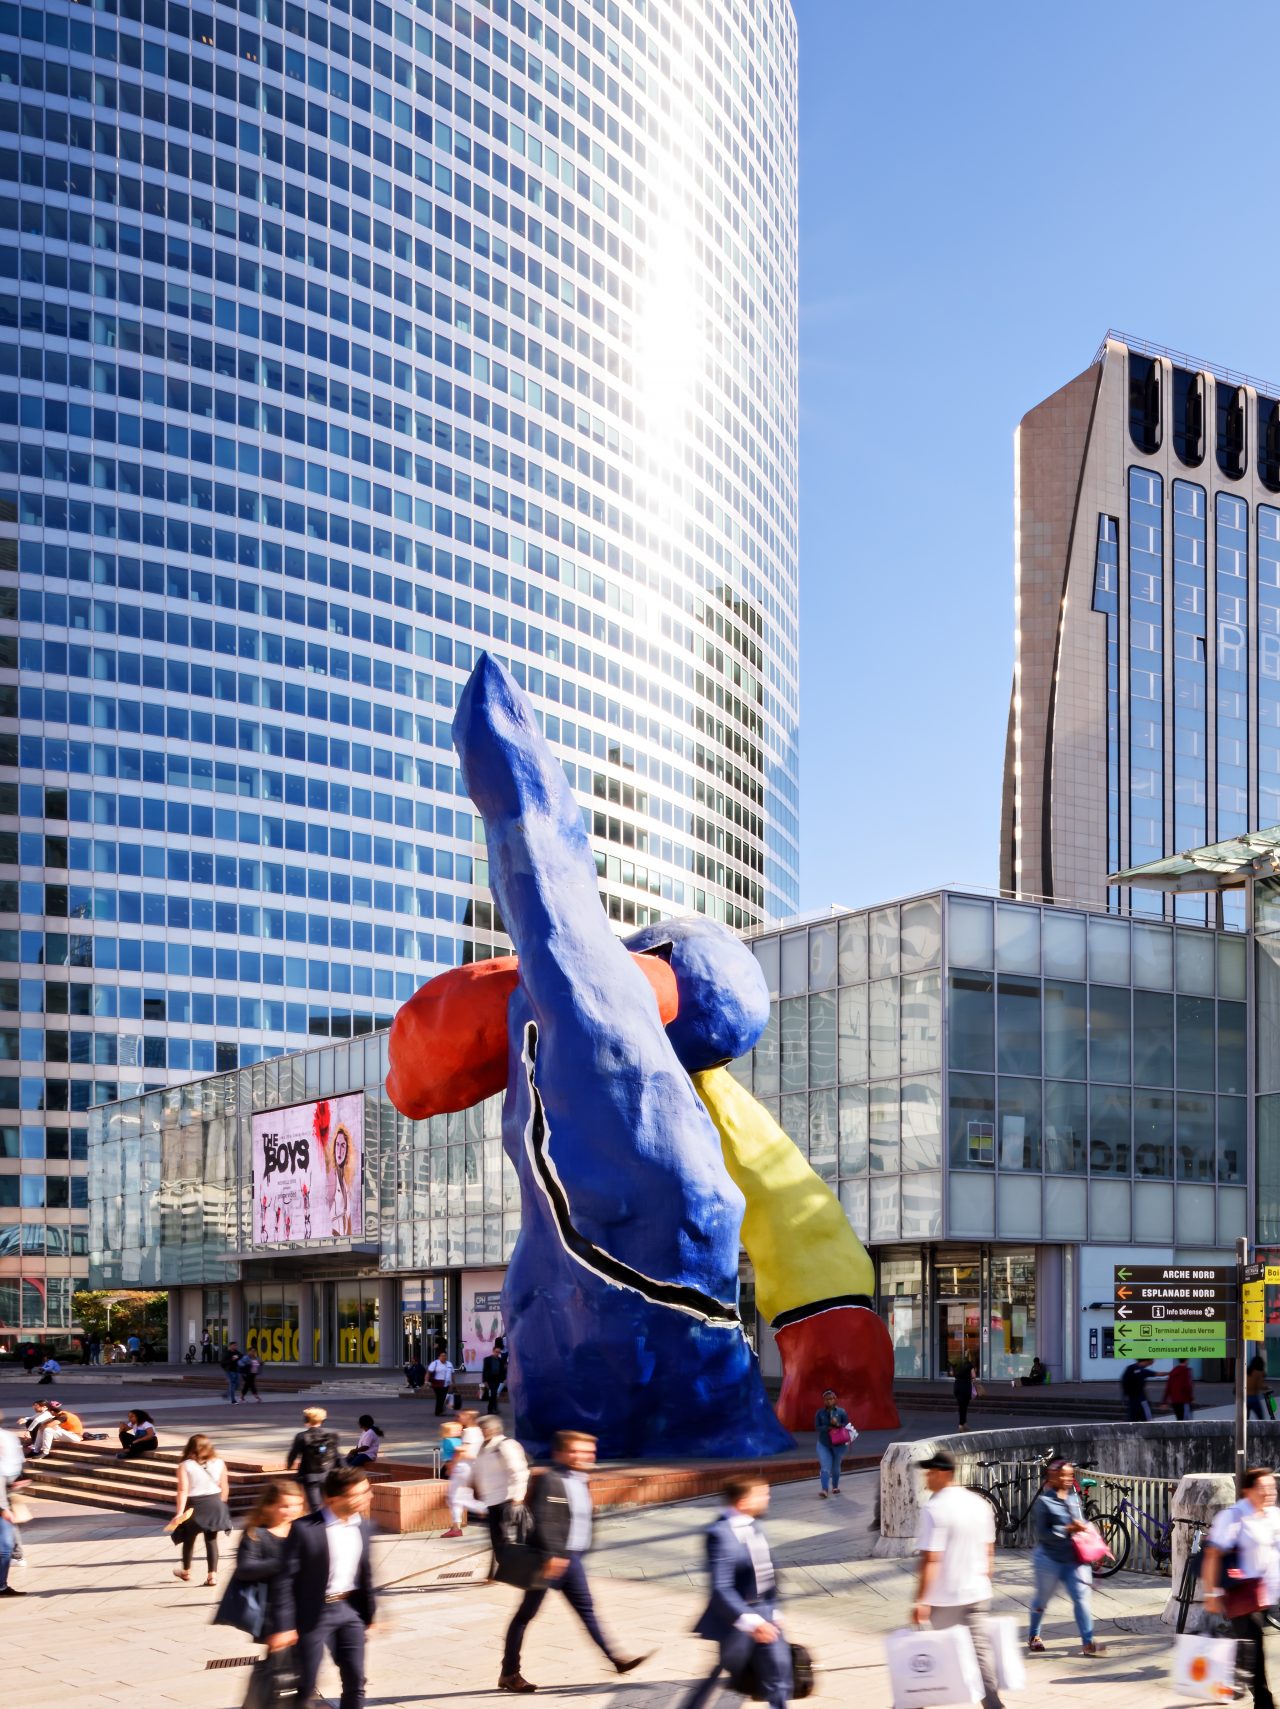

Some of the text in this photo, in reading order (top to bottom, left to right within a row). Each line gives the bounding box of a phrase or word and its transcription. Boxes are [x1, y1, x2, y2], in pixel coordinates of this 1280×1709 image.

[262, 1133, 279, 1147] THE
[263, 1138, 310, 1178] BOYS
[1163, 1270, 1215, 1279] ARCHE NORD
[1142, 1289, 1215, 1297] ESPLANADE NORD
